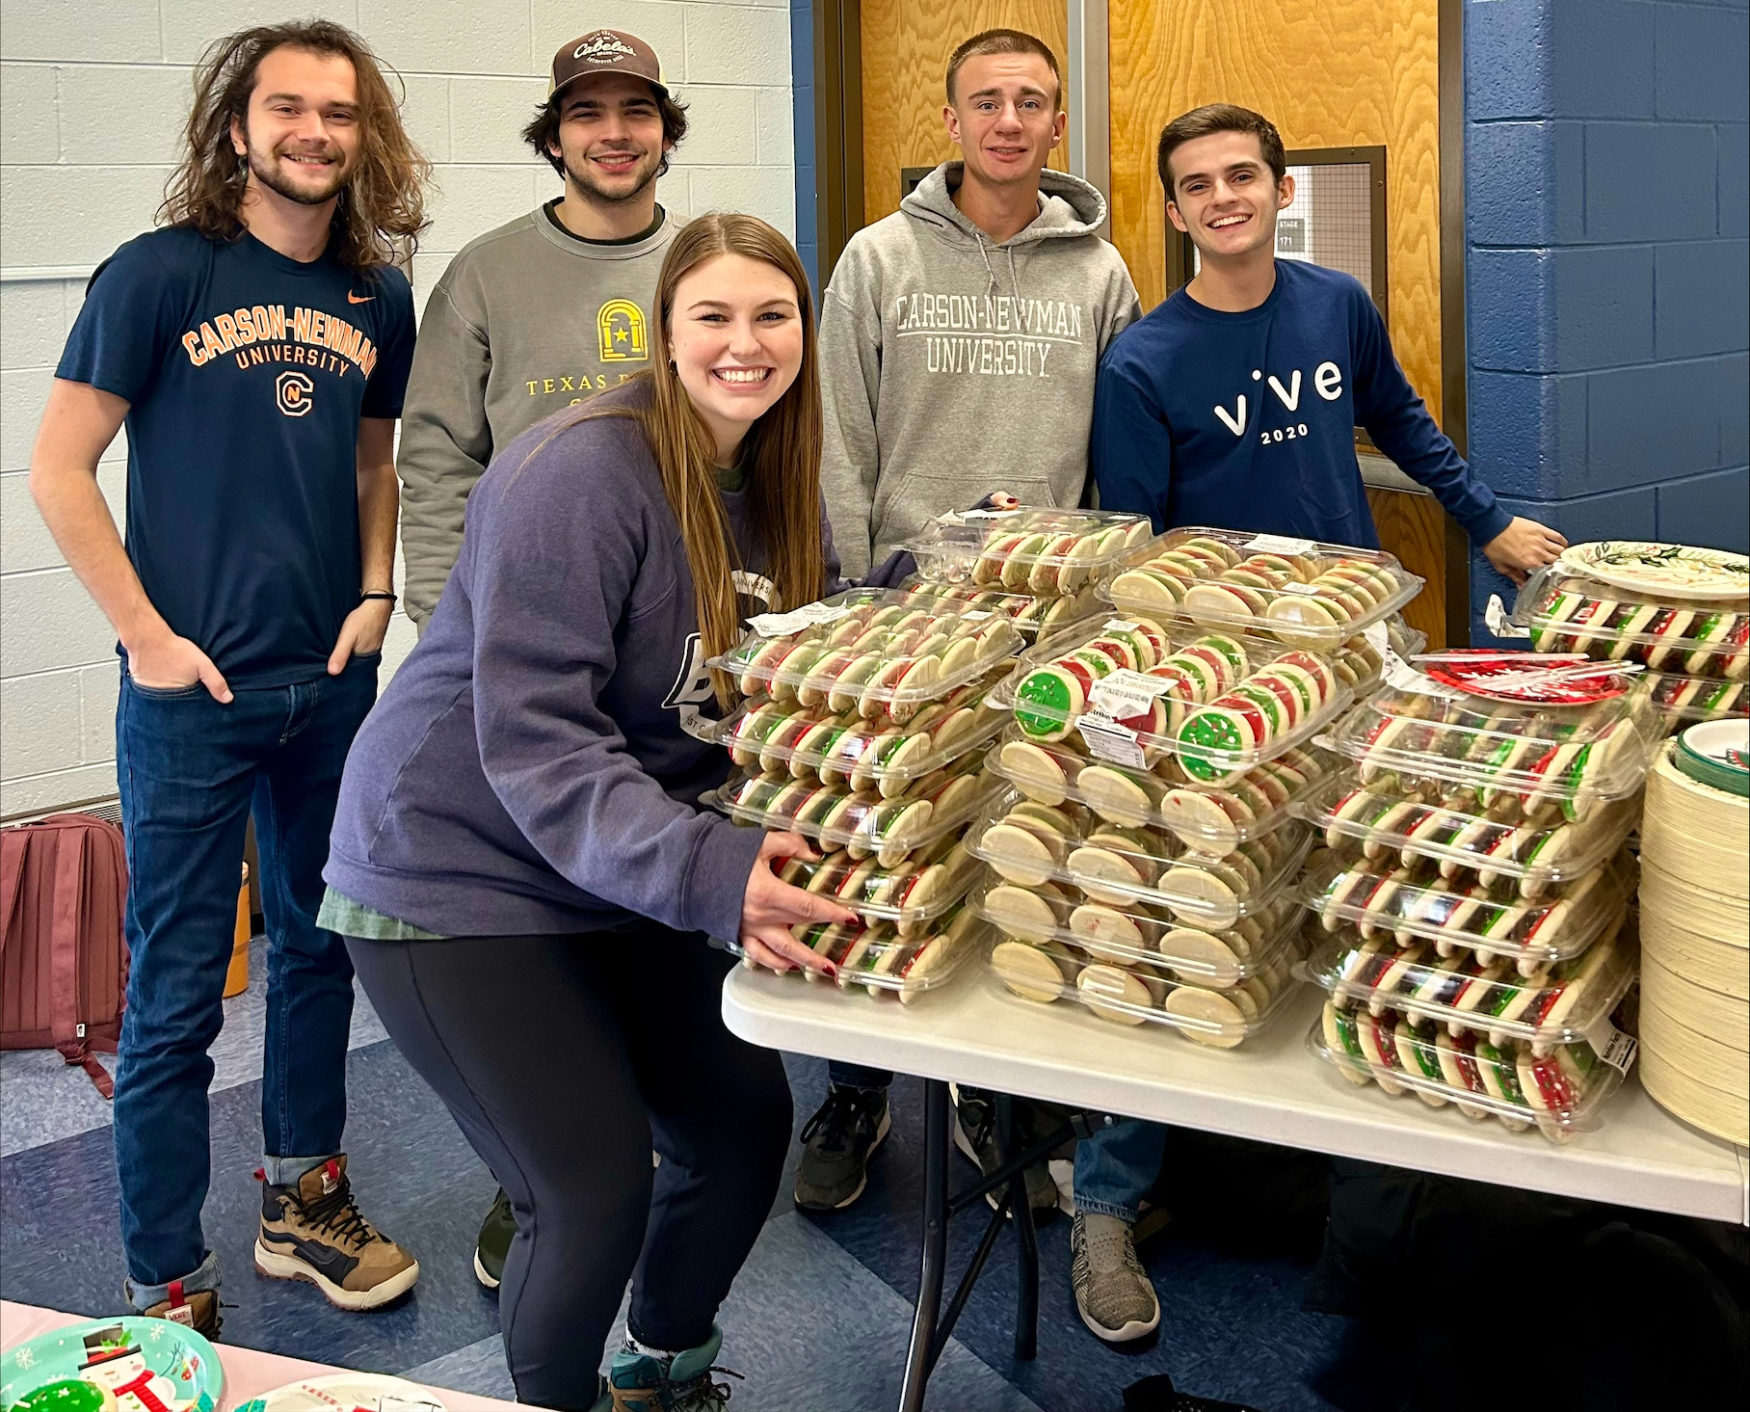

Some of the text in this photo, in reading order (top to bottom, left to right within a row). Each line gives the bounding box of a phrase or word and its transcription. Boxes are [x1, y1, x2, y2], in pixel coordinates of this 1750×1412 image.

[896, 292, 1081, 338] CARSON-NEWMAN
[235, 344, 350, 378] UNIVERSITY
[926, 337, 1052, 378] UNIVERSITY
[525, 374, 607, 397] TEXAS
[1213, 361, 1343, 437] vve
[1260, 423, 1309, 445] 2020
